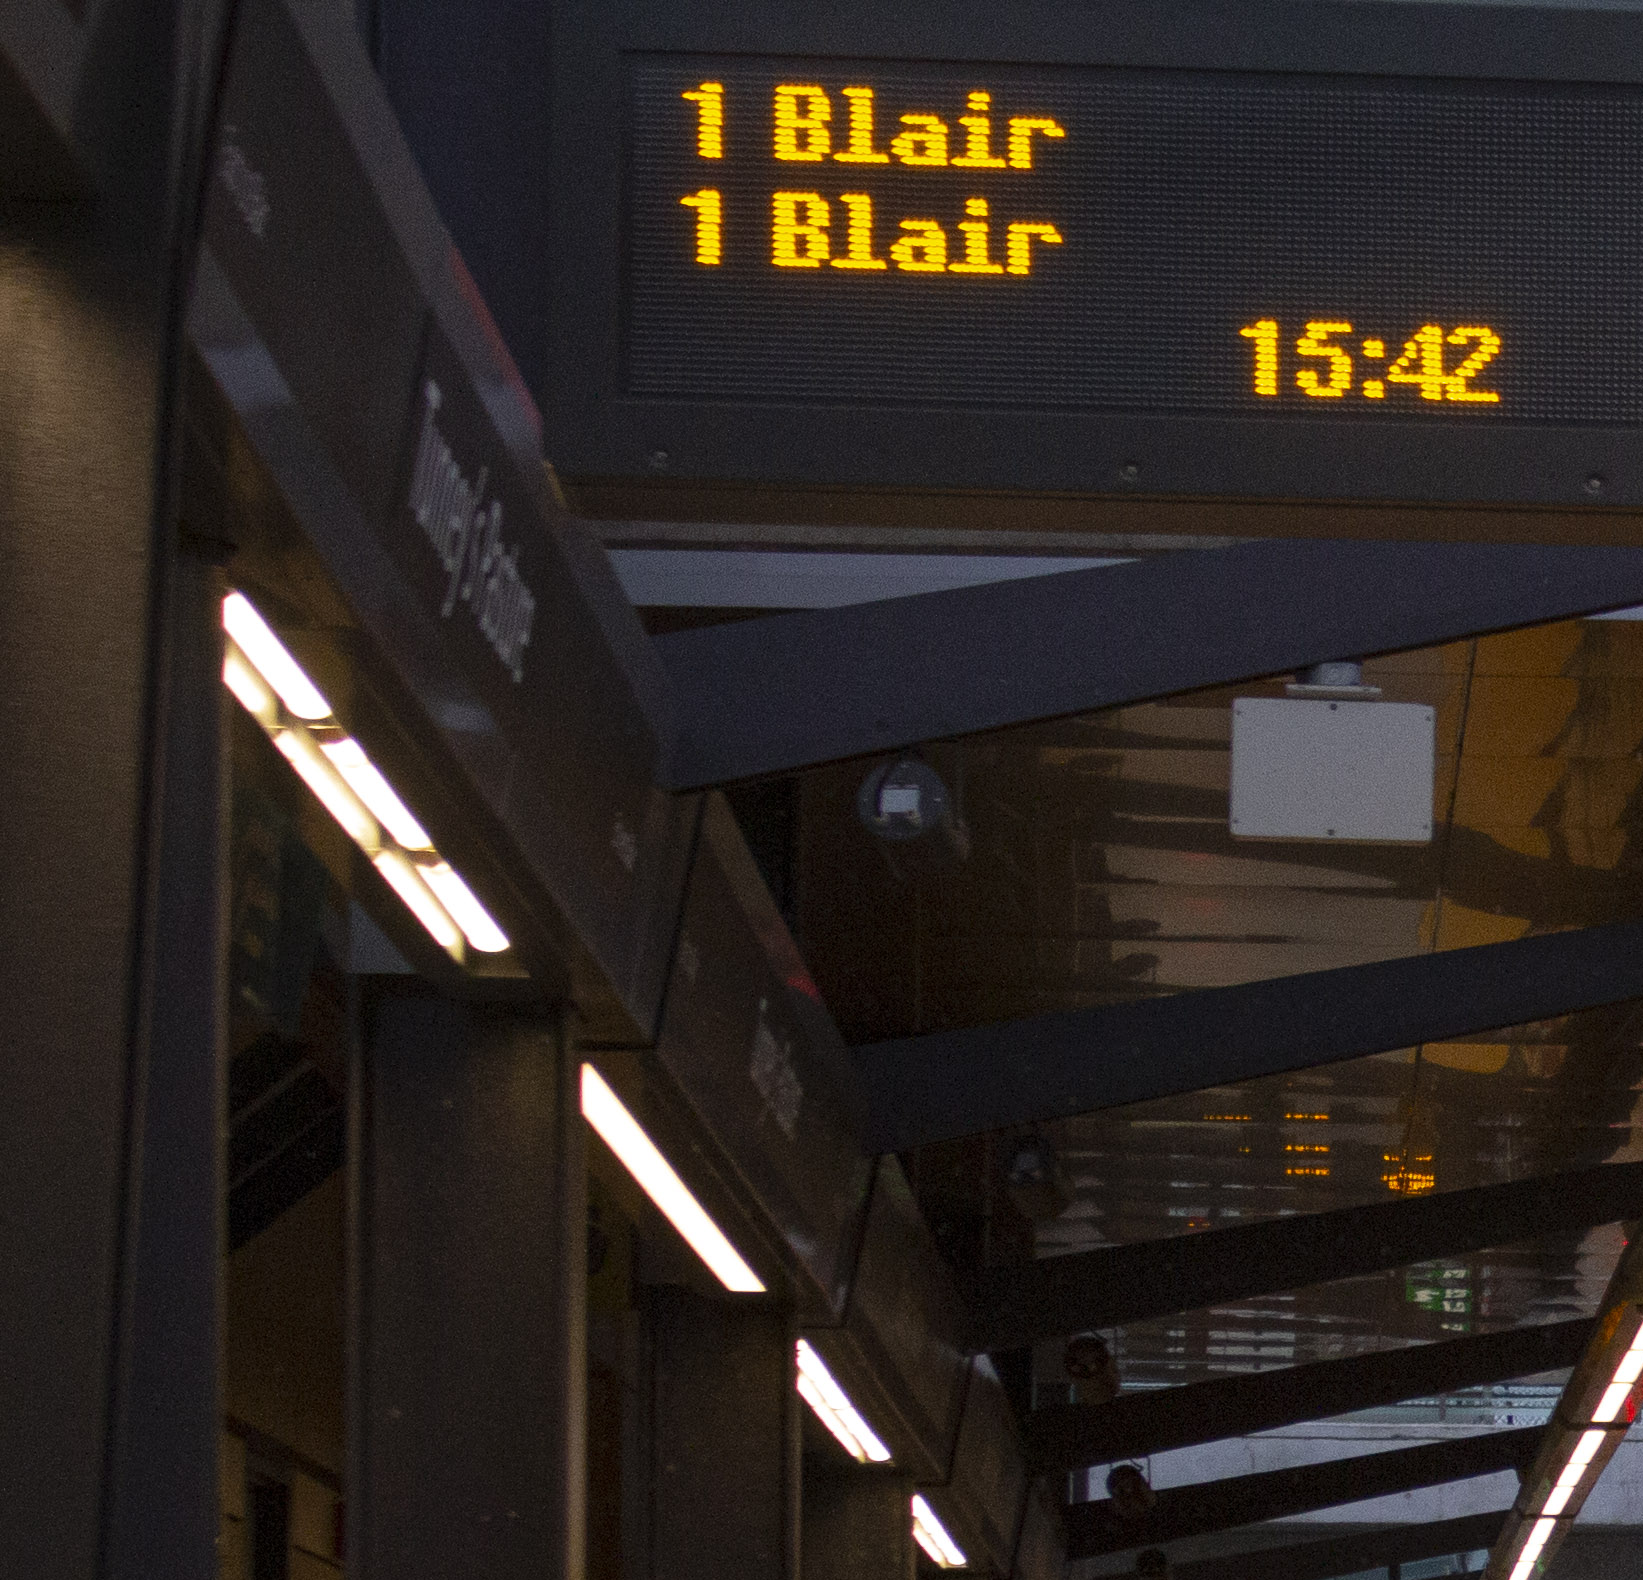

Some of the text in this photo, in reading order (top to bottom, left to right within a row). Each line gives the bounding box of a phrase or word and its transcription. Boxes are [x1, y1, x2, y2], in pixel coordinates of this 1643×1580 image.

[681, 82, 724, 159] 1
[774, 84, 1066, 168] Blair
[679, 189, 721, 266] 1
[771, 191, 1063, 275] Blair
[1238, 320, 1500, 402] 15:42
